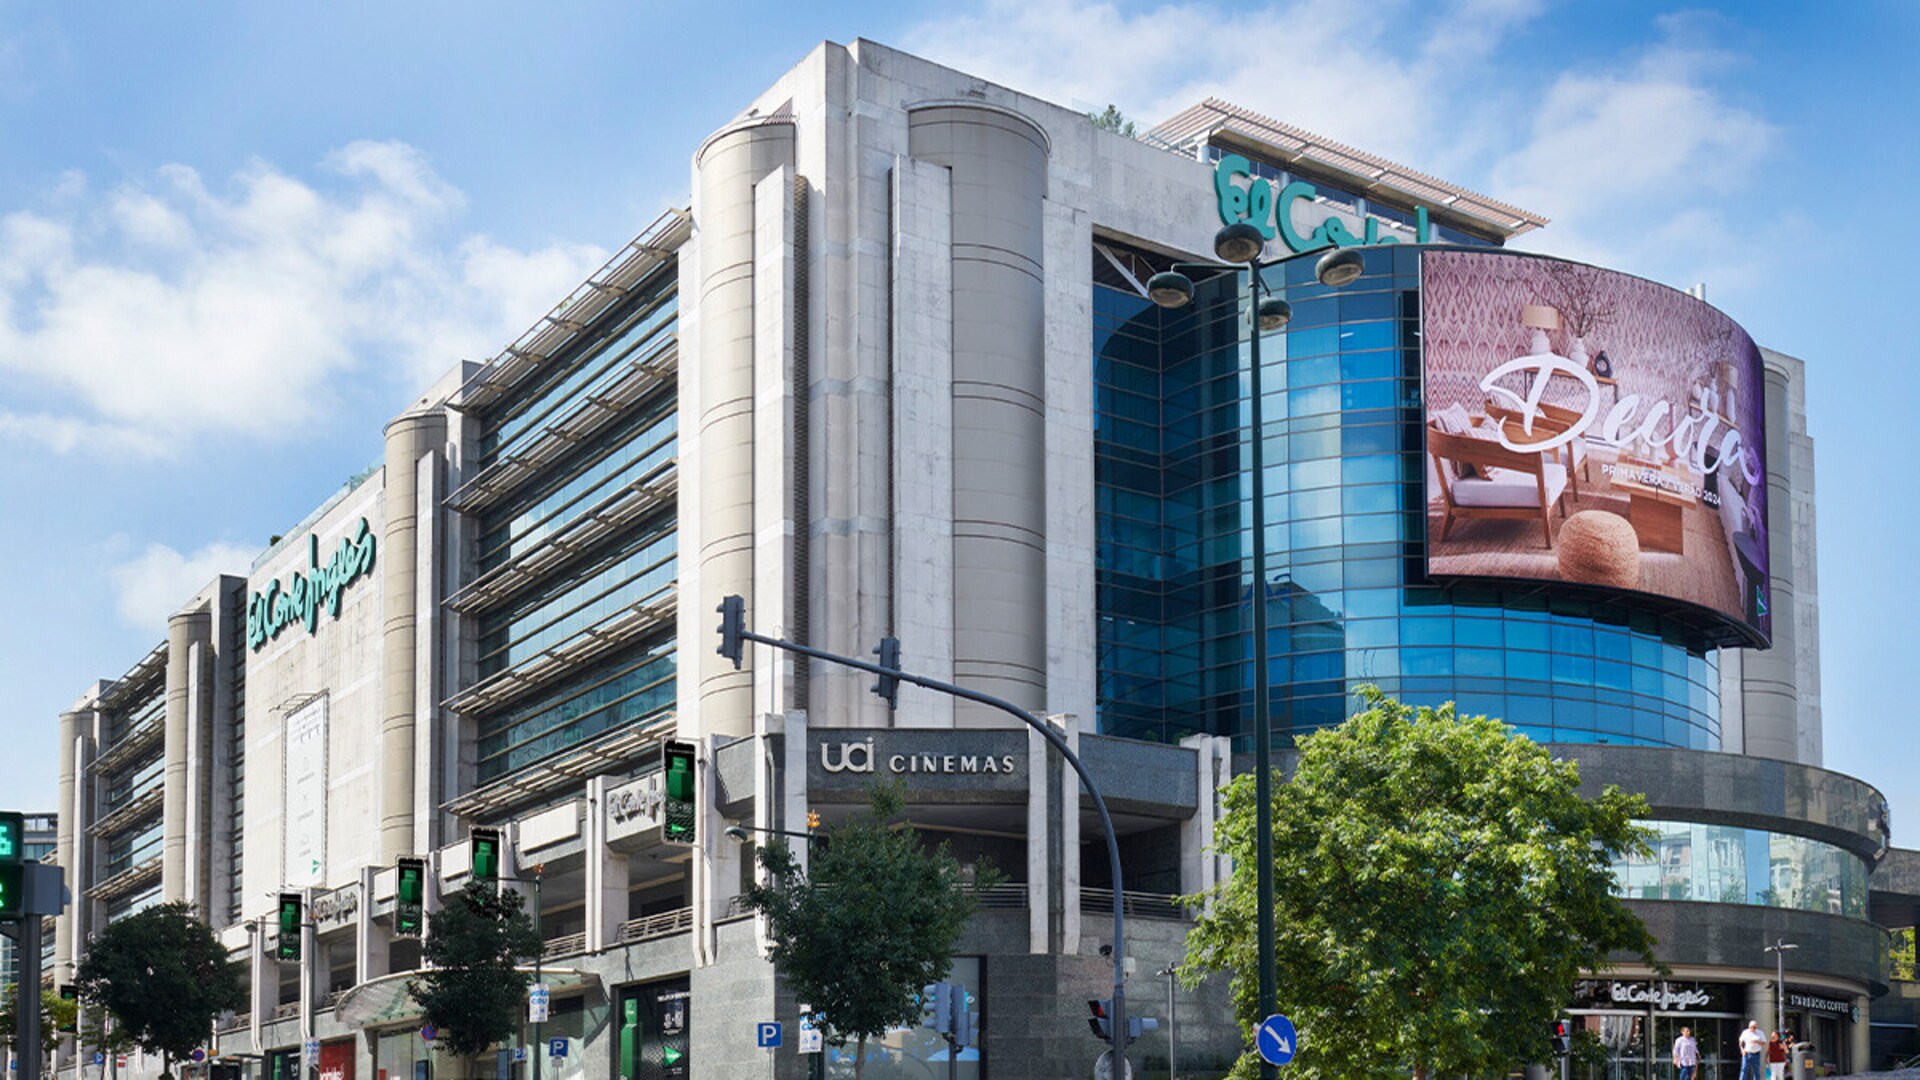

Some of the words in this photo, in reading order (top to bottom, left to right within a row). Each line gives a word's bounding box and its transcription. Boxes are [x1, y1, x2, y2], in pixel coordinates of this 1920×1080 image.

[1479, 351, 1763, 486] Decora
[248, 591, 265, 650] El
[263, 572, 306, 638] Corte
[304, 517, 376, 634] Inglés
[888, 754, 1015, 773] CINEMAS
[1610, 982, 1629, 1002] El
[1627, 984, 1661, 1004] Corte
[1659, 981, 1710, 1011] Inglés
[1790, 994, 1827, 1010] STARBUCKS
[1826, 1000, 1849, 1014] COFFEE
[762, 1025, 777, 1045] P
[553, 1041, 564, 1054] P
